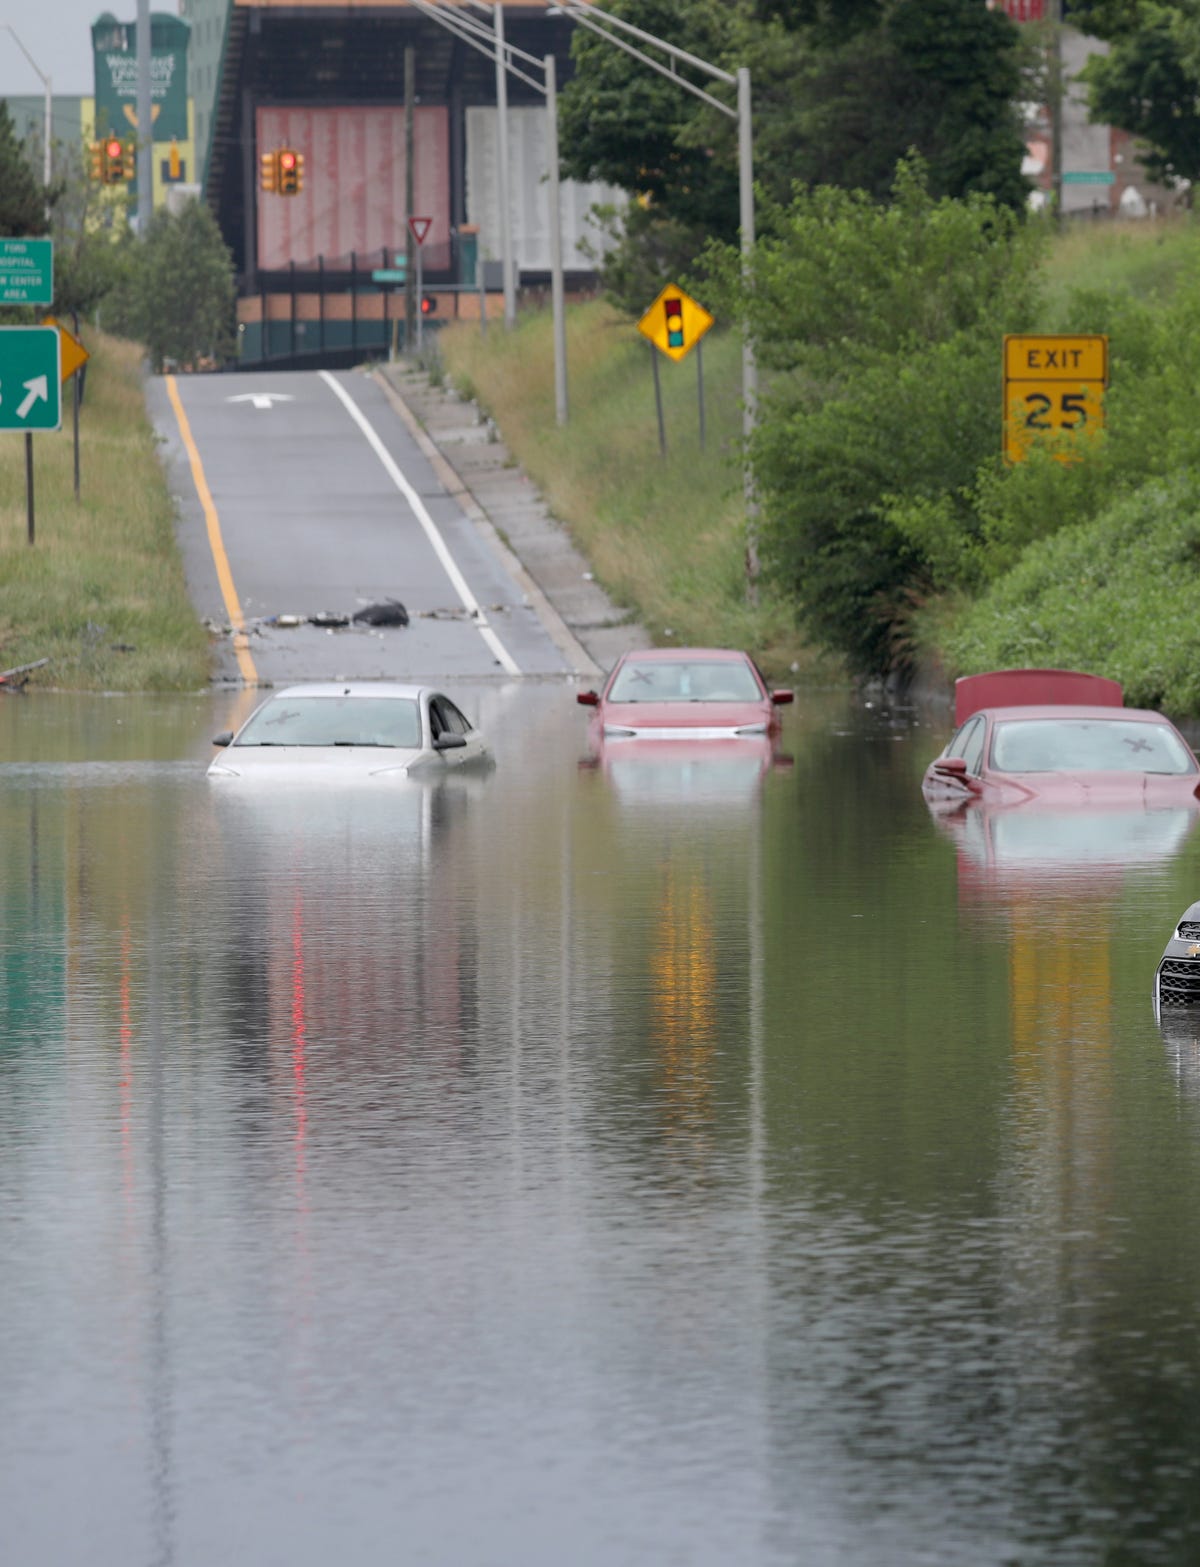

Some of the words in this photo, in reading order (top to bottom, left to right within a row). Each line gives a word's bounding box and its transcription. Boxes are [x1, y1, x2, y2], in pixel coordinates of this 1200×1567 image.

[4, 244, 27, 254] FORD
[0, 257, 35, 268] OSPITAL
[10, 276, 42, 287] CENTER
[3, 289, 28, 299] AREA
[1027, 349, 1083, 368] EXIT
[1025, 393, 1087, 429] 25
